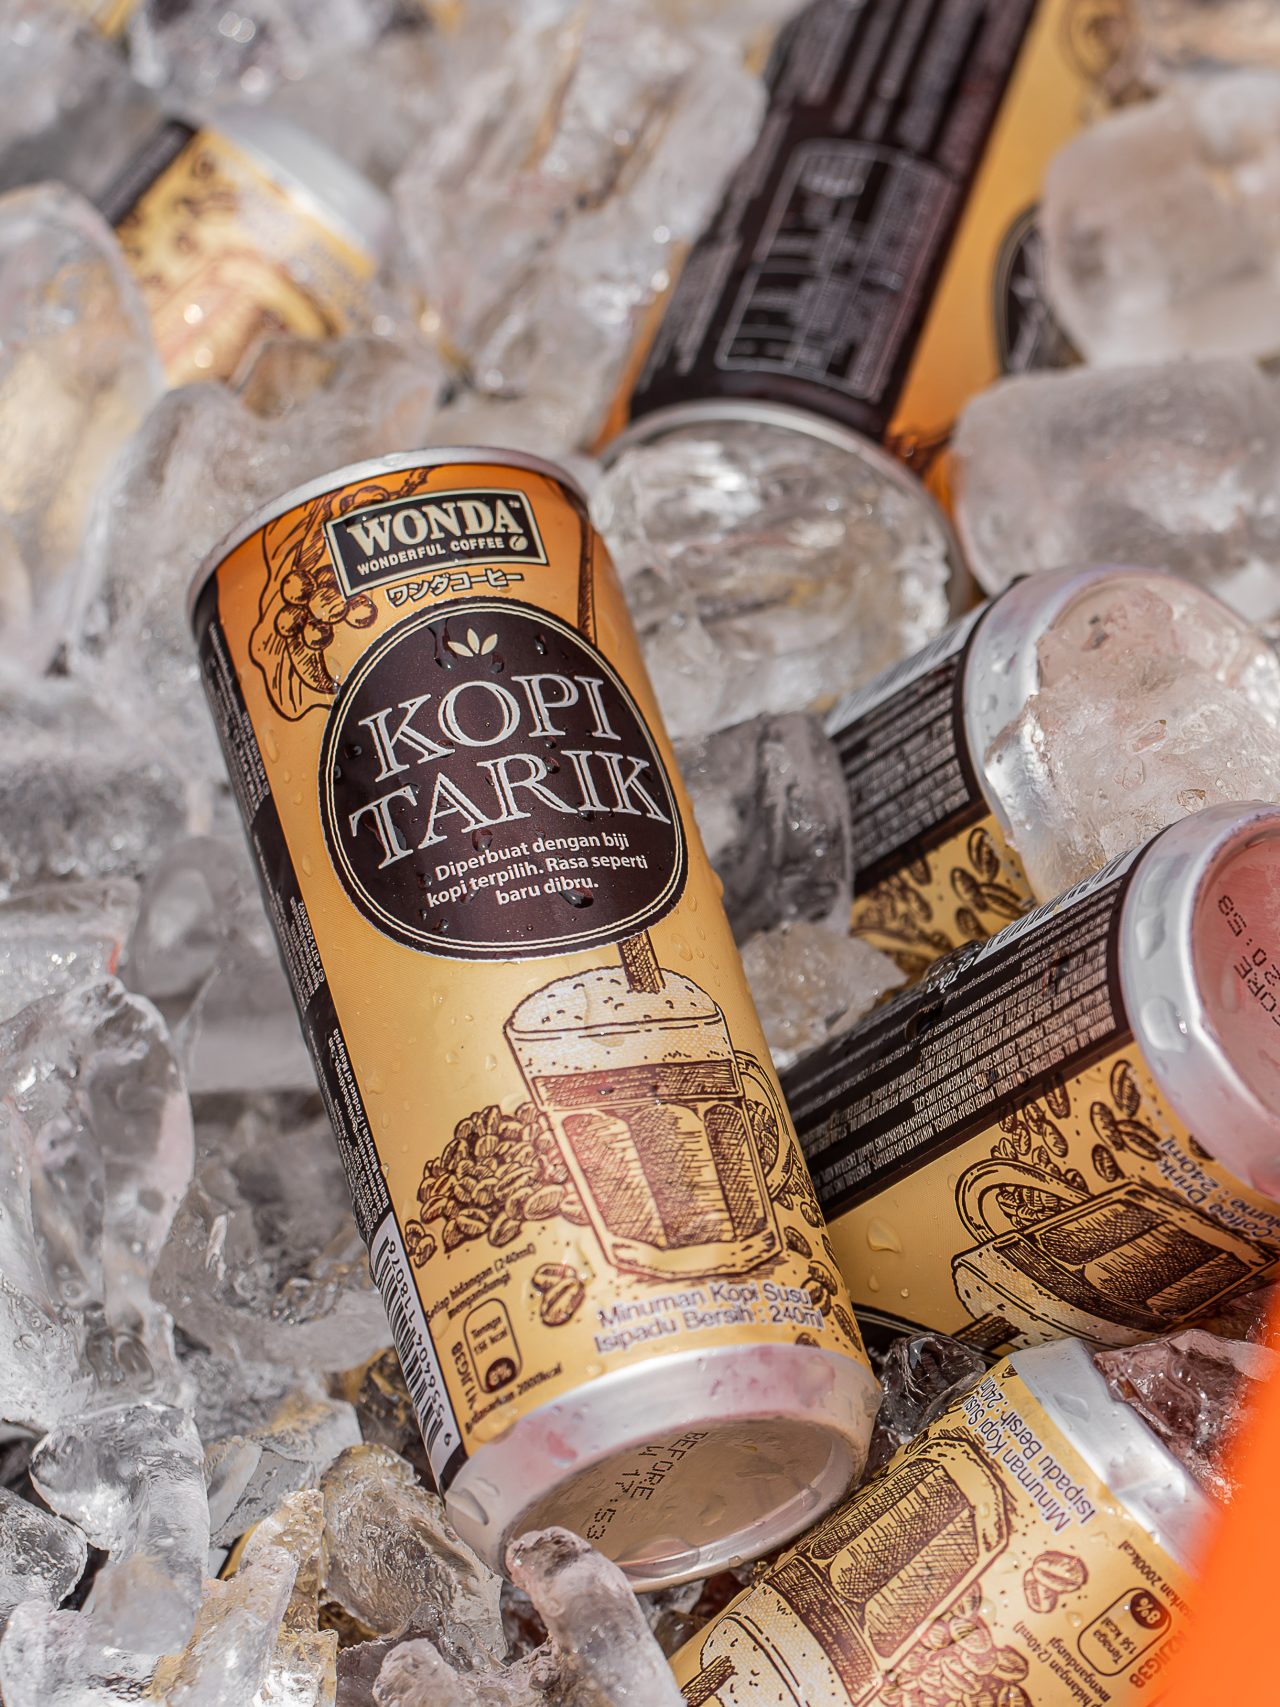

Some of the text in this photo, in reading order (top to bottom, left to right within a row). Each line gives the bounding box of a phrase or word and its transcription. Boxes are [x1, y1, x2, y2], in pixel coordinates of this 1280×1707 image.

[347, 499, 524, 557] WONDA
[357, 537, 505, 576] WONDERFUL COFFEE
[385, 567, 524, 608] ワンダコーヒー
[358, 674, 622, 783] KOPI
[350, 750, 671, 870] TARIK
[435, 832, 630, 882] Diperbuat dengan biji
[426, 855, 649, 908] kopi terpilih. Rasa seperti
[496, 876, 599, 905] baru dibru.
[297, 900, 313, 942] 2450102
[332, 1028, 351, 1071] Malaysia
[346, 1071, 352, 1083] of
[349, 1083, 364, 1122] Product
[362, 1127, 379, 1173] Malaysia
[1161, 1135, 1219, 1193] 240ml
[375, 1172, 389, 1209] Buatan
[1159, 1157, 1207, 1204] Drink
[1208, 1201, 1273, 1238] Coffee
[388, 1240, 416, 1323] 118076
[599, 1280, 813, 1329] Minuman Kopi Susu
[471, 1316, 502, 1340] Tenaga
[489, 1327, 509, 1346] kcal
[594, 1315, 679, 1354] Isipadu
[682, 1301, 755, 1330] Bersih
[769, 1303, 825, 1329] 240ml
[415, 1333, 445, 1419] 556404
[974, 1417, 1008, 1456] Kopi
[1000, 1411, 1043, 1460] Bersih
[630, 1431, 709, 1500] BEFORE
[1001, 1448, 1071, 1532] Minuman
[1038, 1455, 1096, 1524] Isipadu
[1118, 1540, 1162, 1587] 2000kcal
[1101, 1617, 1122, 1640] kcal
[1136, 1597, 1161, 1625] 8%
[1013, 1620, 1093, 1707] hidangan (240ml)
[1049, 1637, 1111, 1703] mengandungi
[1093, 1628, 1124, 1665] Tenaga
